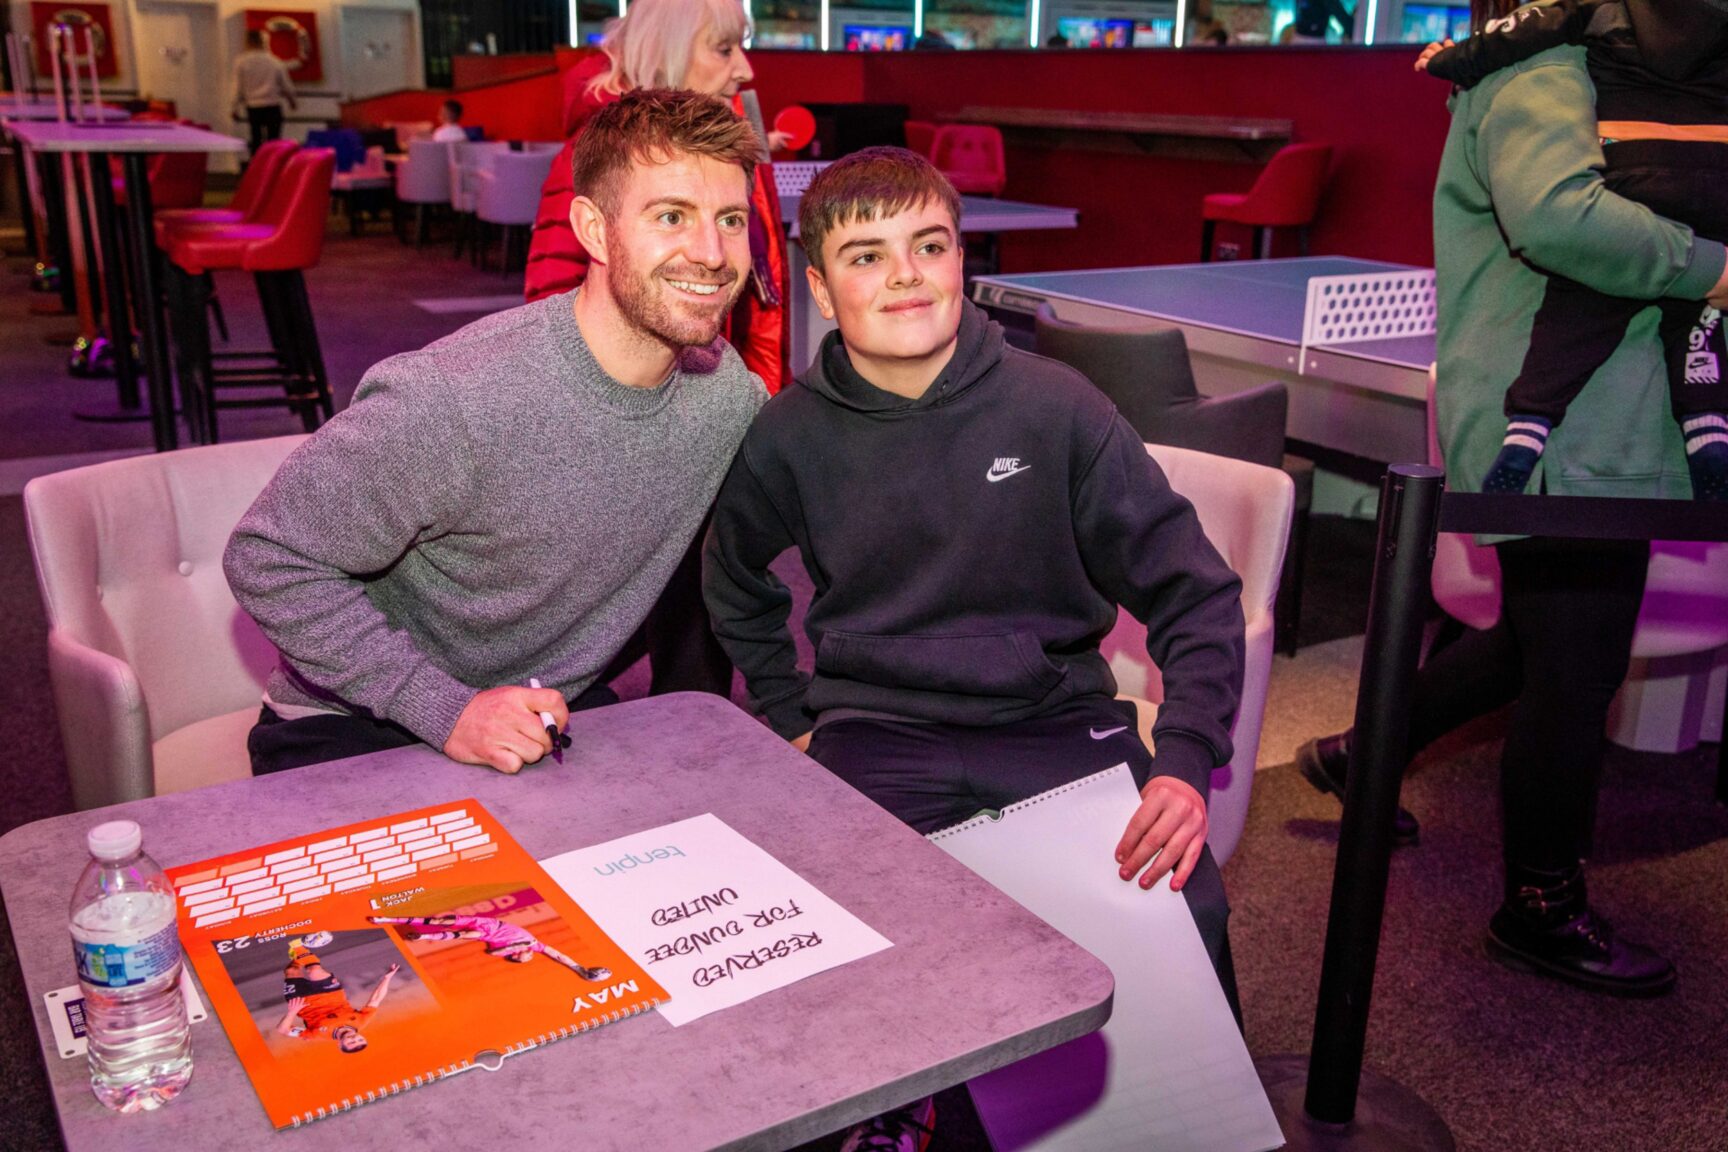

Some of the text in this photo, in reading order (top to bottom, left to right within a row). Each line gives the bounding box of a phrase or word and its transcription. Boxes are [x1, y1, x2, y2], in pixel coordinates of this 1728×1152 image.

[992, 457, 1020, 472] NIKE
[593, 845, 687, 876] tenpin
[381, 887, 425, 902] WALTON
[386, 896, 413, 907] JACK
[370, 899, 381, 910] 1
[651, 887, 739, 927] UNITED
[254, 918, 313, 938] DOCHERTY
[644, 899, 804, 965] FOR DUNDEE
[216, 935, 251, 954] 23
[257, 932, 287, 944] ROSS
[692, 931, 823, 987] RESERVED
[572, 979, 640, 1014] MAY
